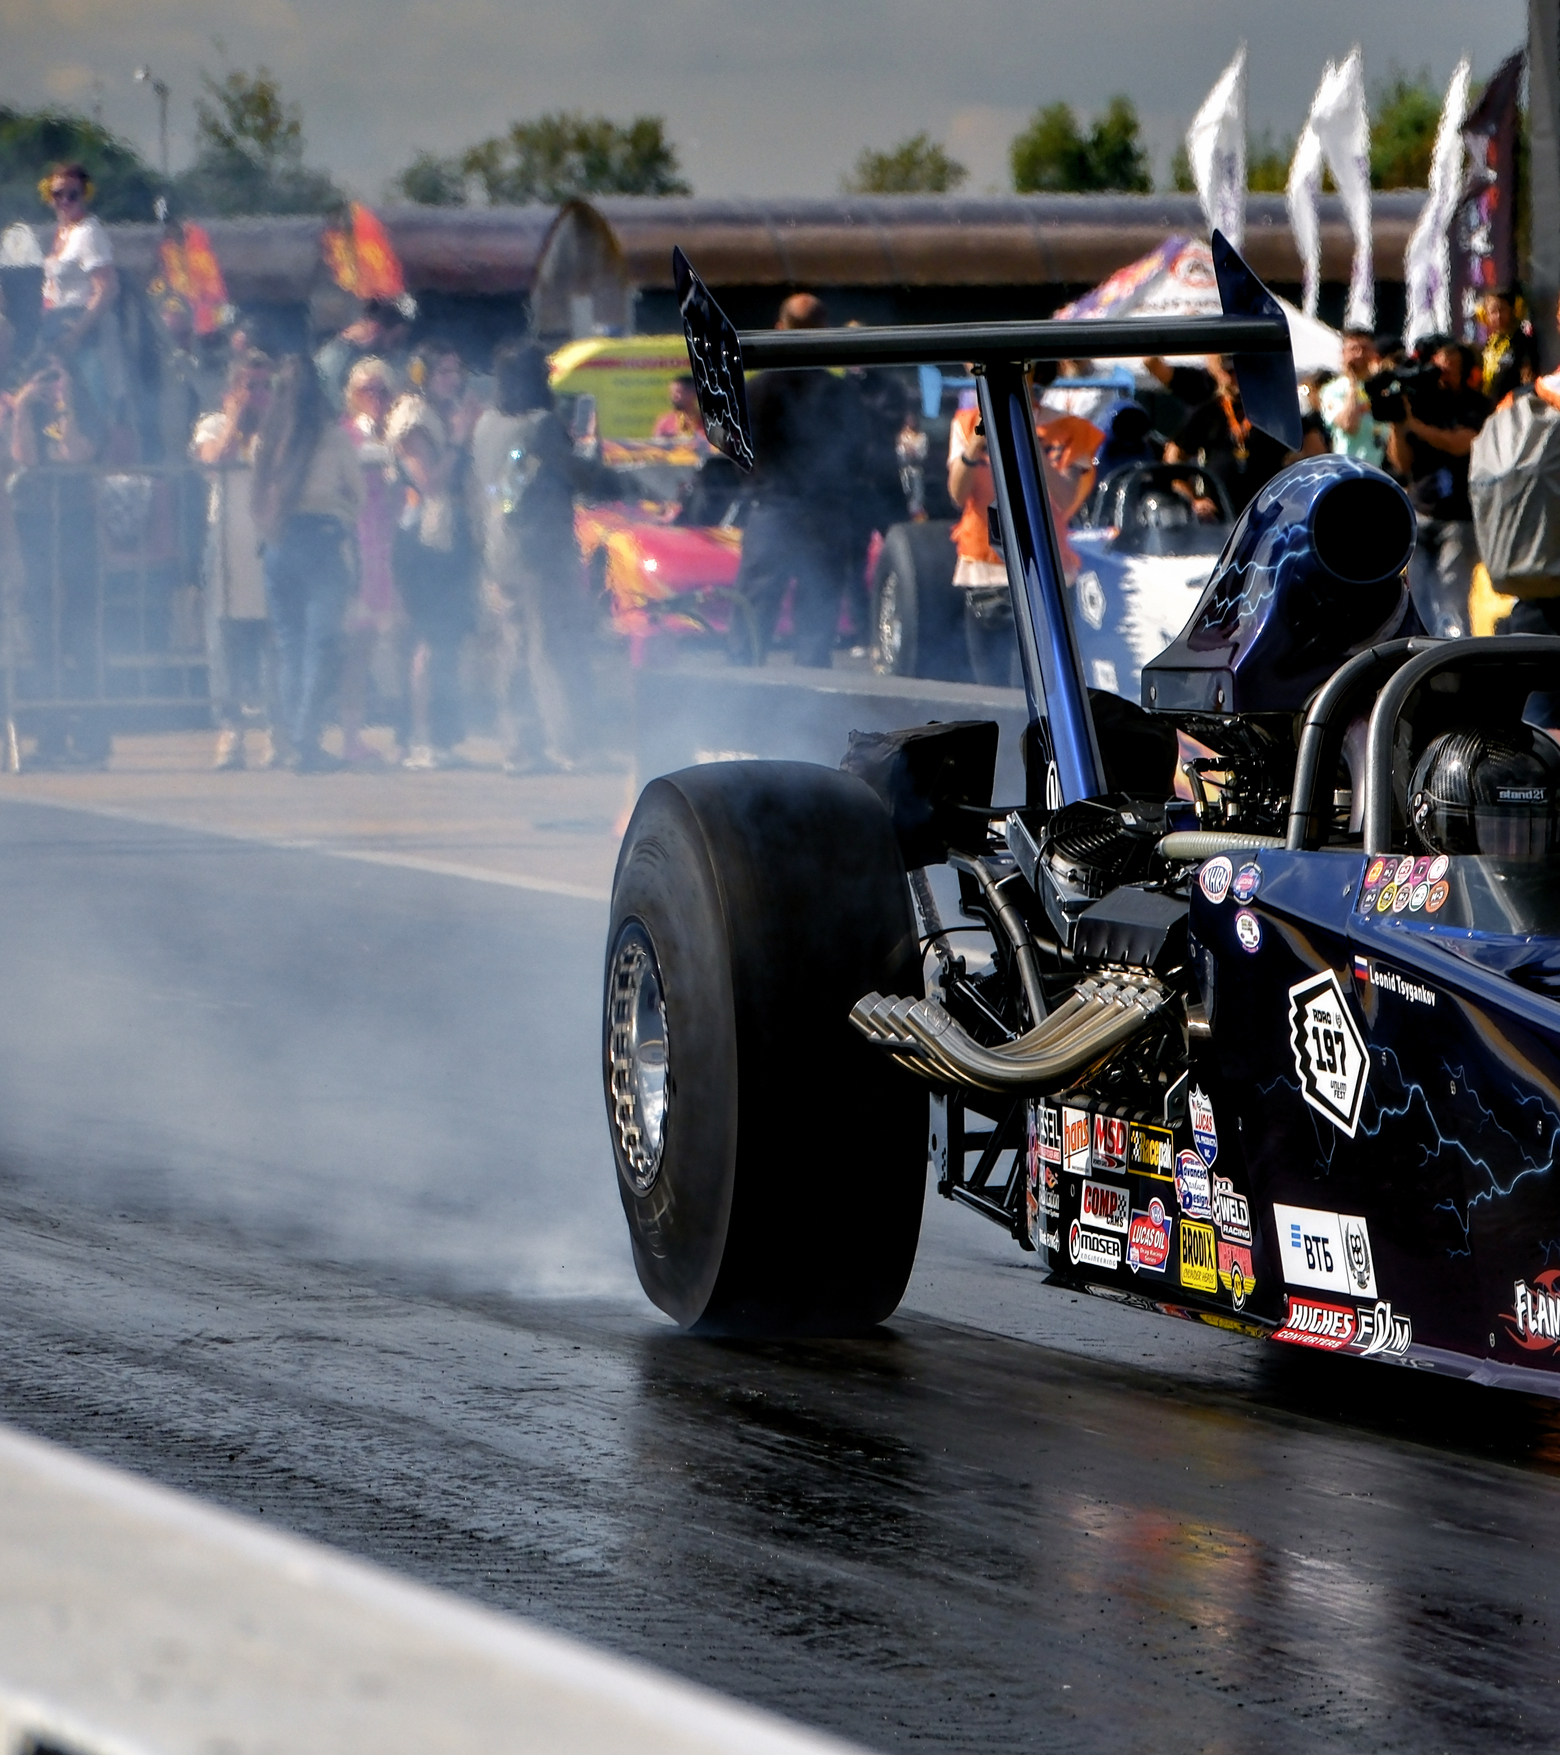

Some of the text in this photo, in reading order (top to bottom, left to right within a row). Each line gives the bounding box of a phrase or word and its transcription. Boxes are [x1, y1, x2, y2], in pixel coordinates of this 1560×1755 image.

[1499, 789, 1544, 799] stand21
[1204, 866, 1228, 893] NHRA
[1369, 965, 1436, 1007] Leonid Tsygankov
[1312, 1026, 1347, 1077] 197
[1333, 1090, 1346, 1100] FEST
[1095, 1117, 1127, 1155] MSD
[1195, 1111, 1212, 1132] LUCAS
[1064, 1110, 1089, 1168] hans
[1139, 1132, 1172, 1174] Racepak
[1084, 1185, 1118, 1217] COMP
[1220, 1196, 1249, 1227] WELD
[1106, 1214, 1124, 1228] CAMS
[1223, 1225, 1250, 1239] RACING
[1081, 1233, 1120, 1257] MOSER
[1131, 1225, 1165, 1250] LUCAS OIL
[1182, 1226, 1215, 1270] BRODIX
[1080, 1253, 1117, 1267] ENGINEERING
[1303, 1234, 1334, 1273] ВТБ
[1287, 1304, 1354, 1339] HUGHES
[1277, 1330, 1343, 1349] CONVERTERS
